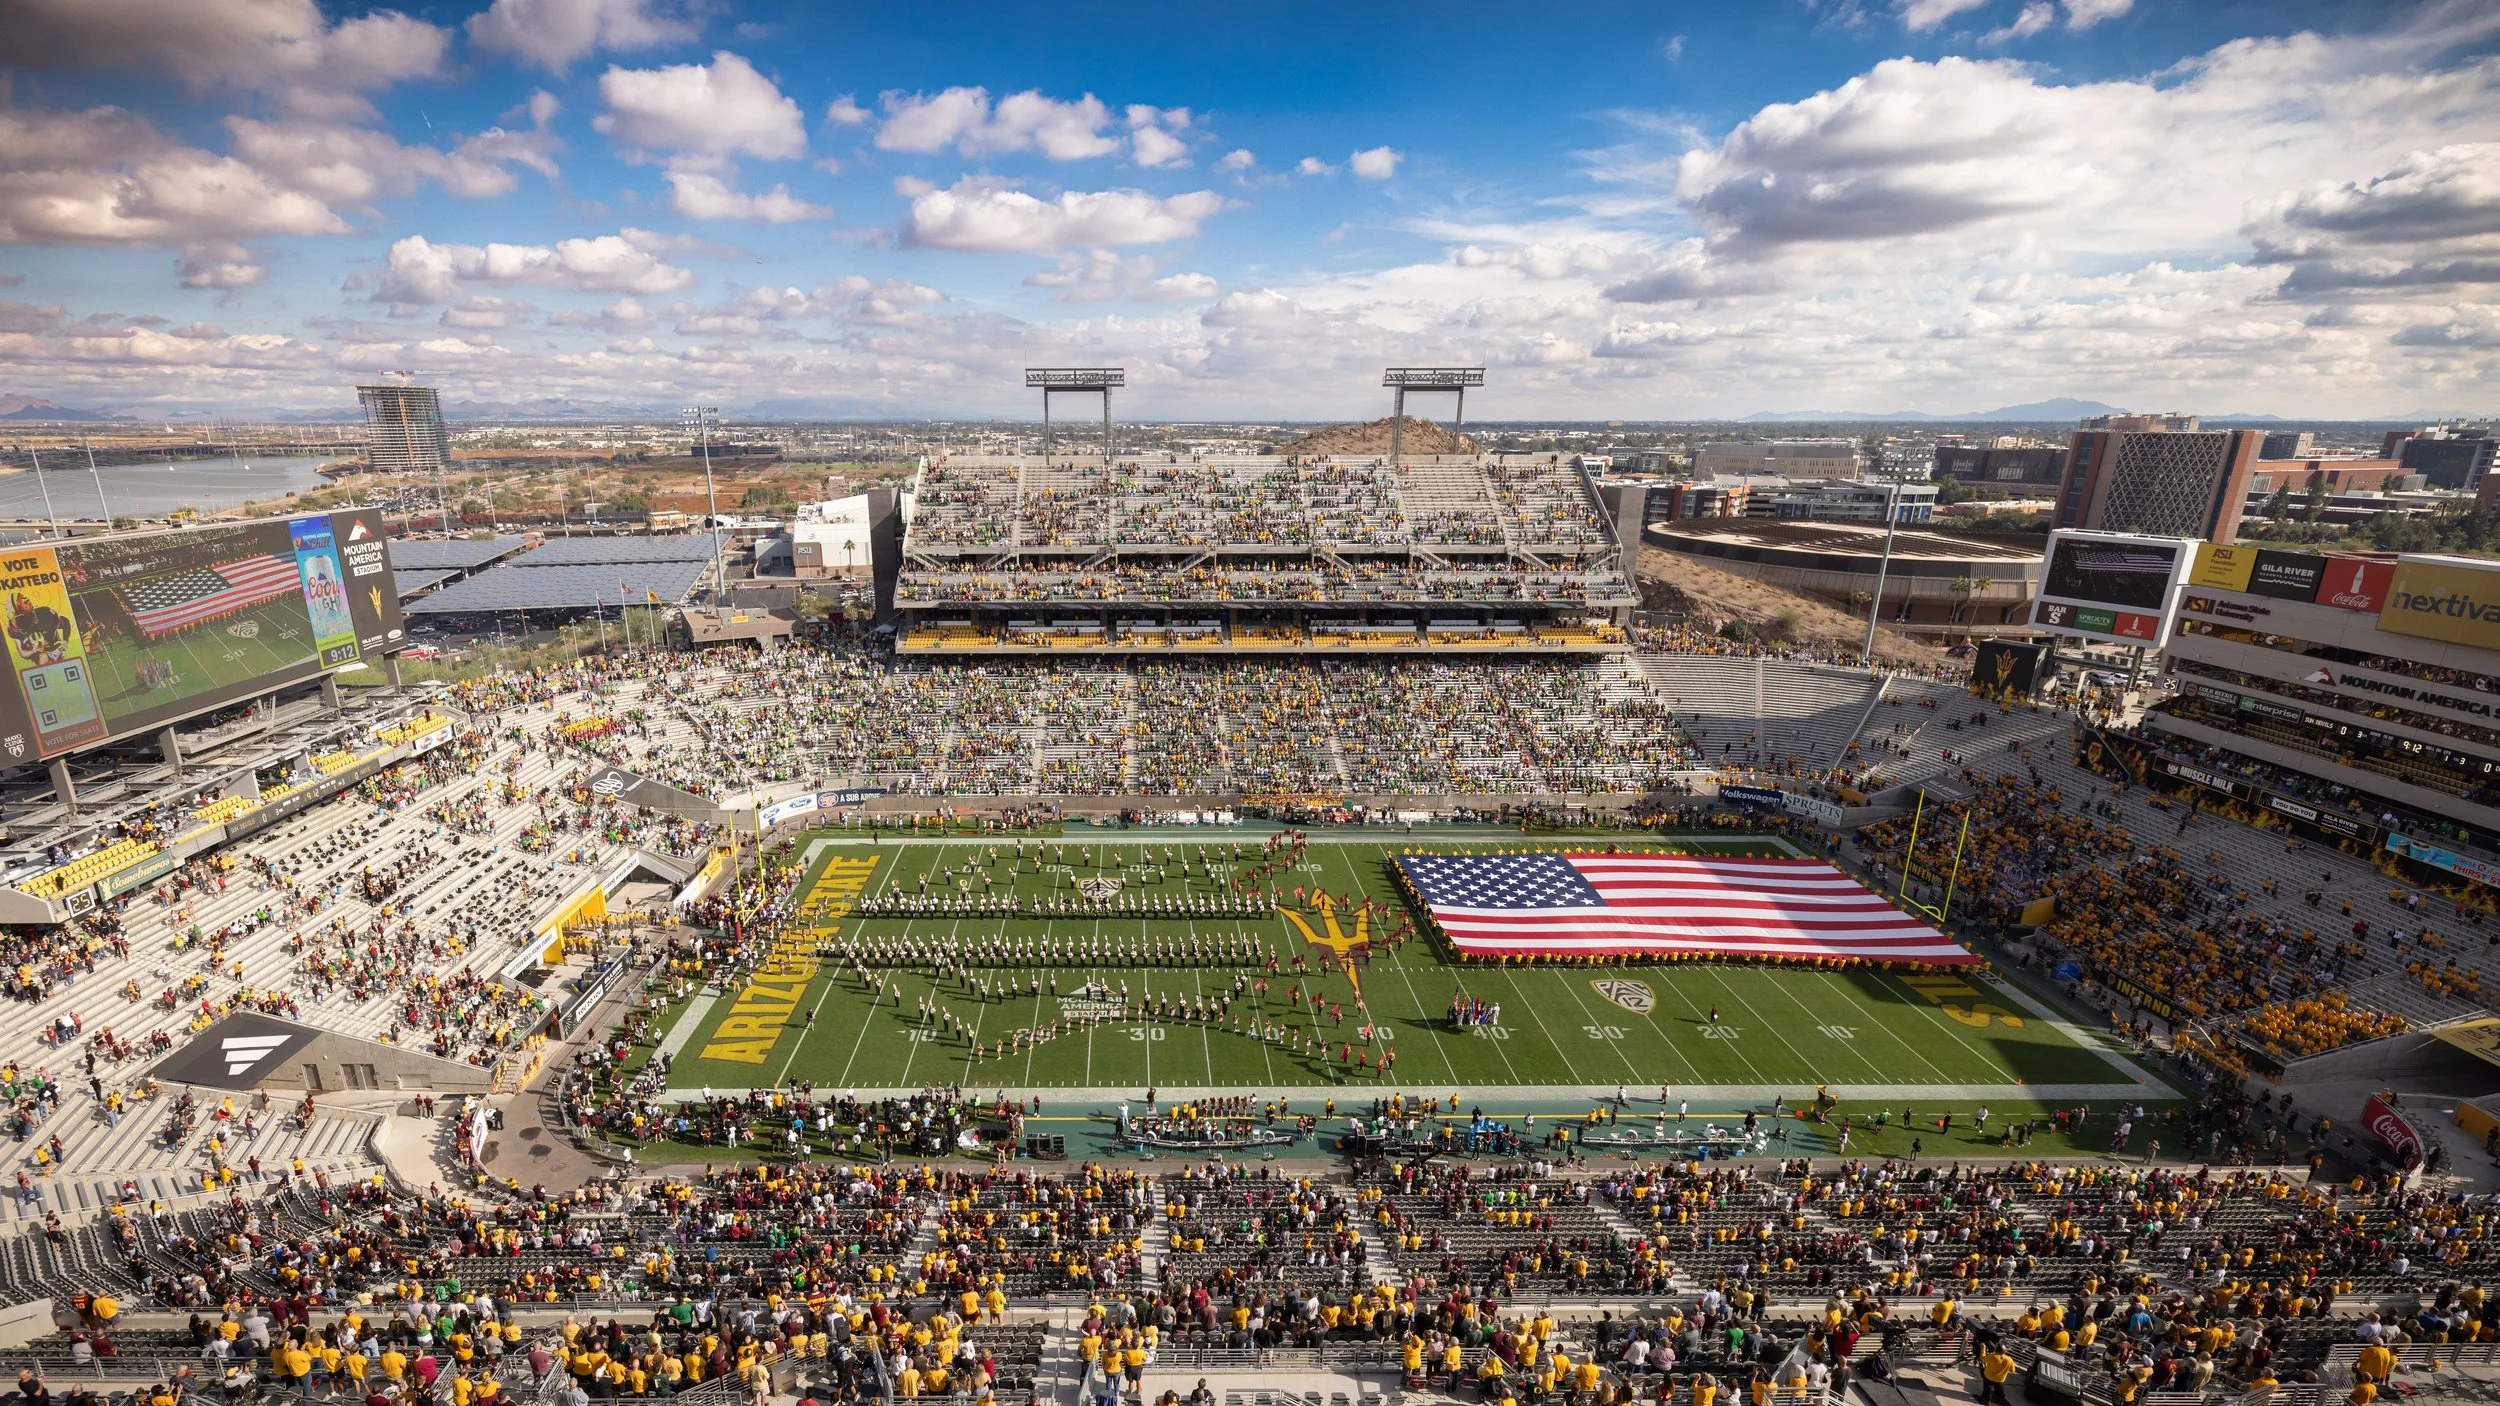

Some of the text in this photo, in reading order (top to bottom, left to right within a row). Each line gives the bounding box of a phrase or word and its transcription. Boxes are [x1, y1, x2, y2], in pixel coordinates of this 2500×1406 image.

[344, 541, 383, 556] MOUNTAIN
[2212, 548, 2233, 560] ASU
[3, 557, 39, 573] VOTE
[349, 552, 383, 566] AMERICA
[357, 564, 380, 575] STADIUM
[2261, 564, 2314, 578] GILA RIVER
[2181, 595, 2216, 615] ASU
[2331, 592, 2372, 609] Coca-Cola
[2048, 605, 2067, 614] BAR
[2395, 592, 2500, 624] nextiva
[2048, 612, 2061, 624] S
[2079, 614, 2111, 624] SPROUTS
[331, 645, 354, 662] 9:12
[2163, 678, 2176, 690] 25
[2339, 674, 2416, 700] MOUNTAIN
[2416, 689, 2490, 717] AMERICA
[2245, 699, 2299, 720] enterprise
[2304, 716, 2333, 728] SUN DEVILS
[45, 725, 99, 746] VOTE FOR SKATT
[2340, 726, 2347, 735] 0
[4, 733, 22, 743] MAYO
[2403, 740, 2422, 754] 9:12
[2483, 763, 2492, 773] 0
[2179, 766, 2212, 784] MUSCLE
[2211, 776, 2234, 793] MILK
[840, 794, 845, 802] A
[846, 793, 860, 802] SUB
[1721, 789, 1780, 805] Volkswagen
[1786, 795, 1840, 819] SPROUTS
[2275, 800, 2314, 818] YOU DO YOU
[2455, 857, 2477, 868] CIRCLE
[2452, 864, 2487, 880] THIRST
[72, 894, 91, 913] 25
[698, 926, 841, 1065] ARIZONA
[2116, 979, 2171, 1018] INFERNO
[908, 1028, 937, 1042] 10
[1130, 1028, 1165, 1041] 30
[1472, 1026, 1509, 1039] 40
[1582, 1026, 1625, 1039] 30
[1696, 1026, 1739, 1039] 20
[1816, 1025, 1855, 1039] 10
[2373, 1114, 2418, 1168] Coca-C
